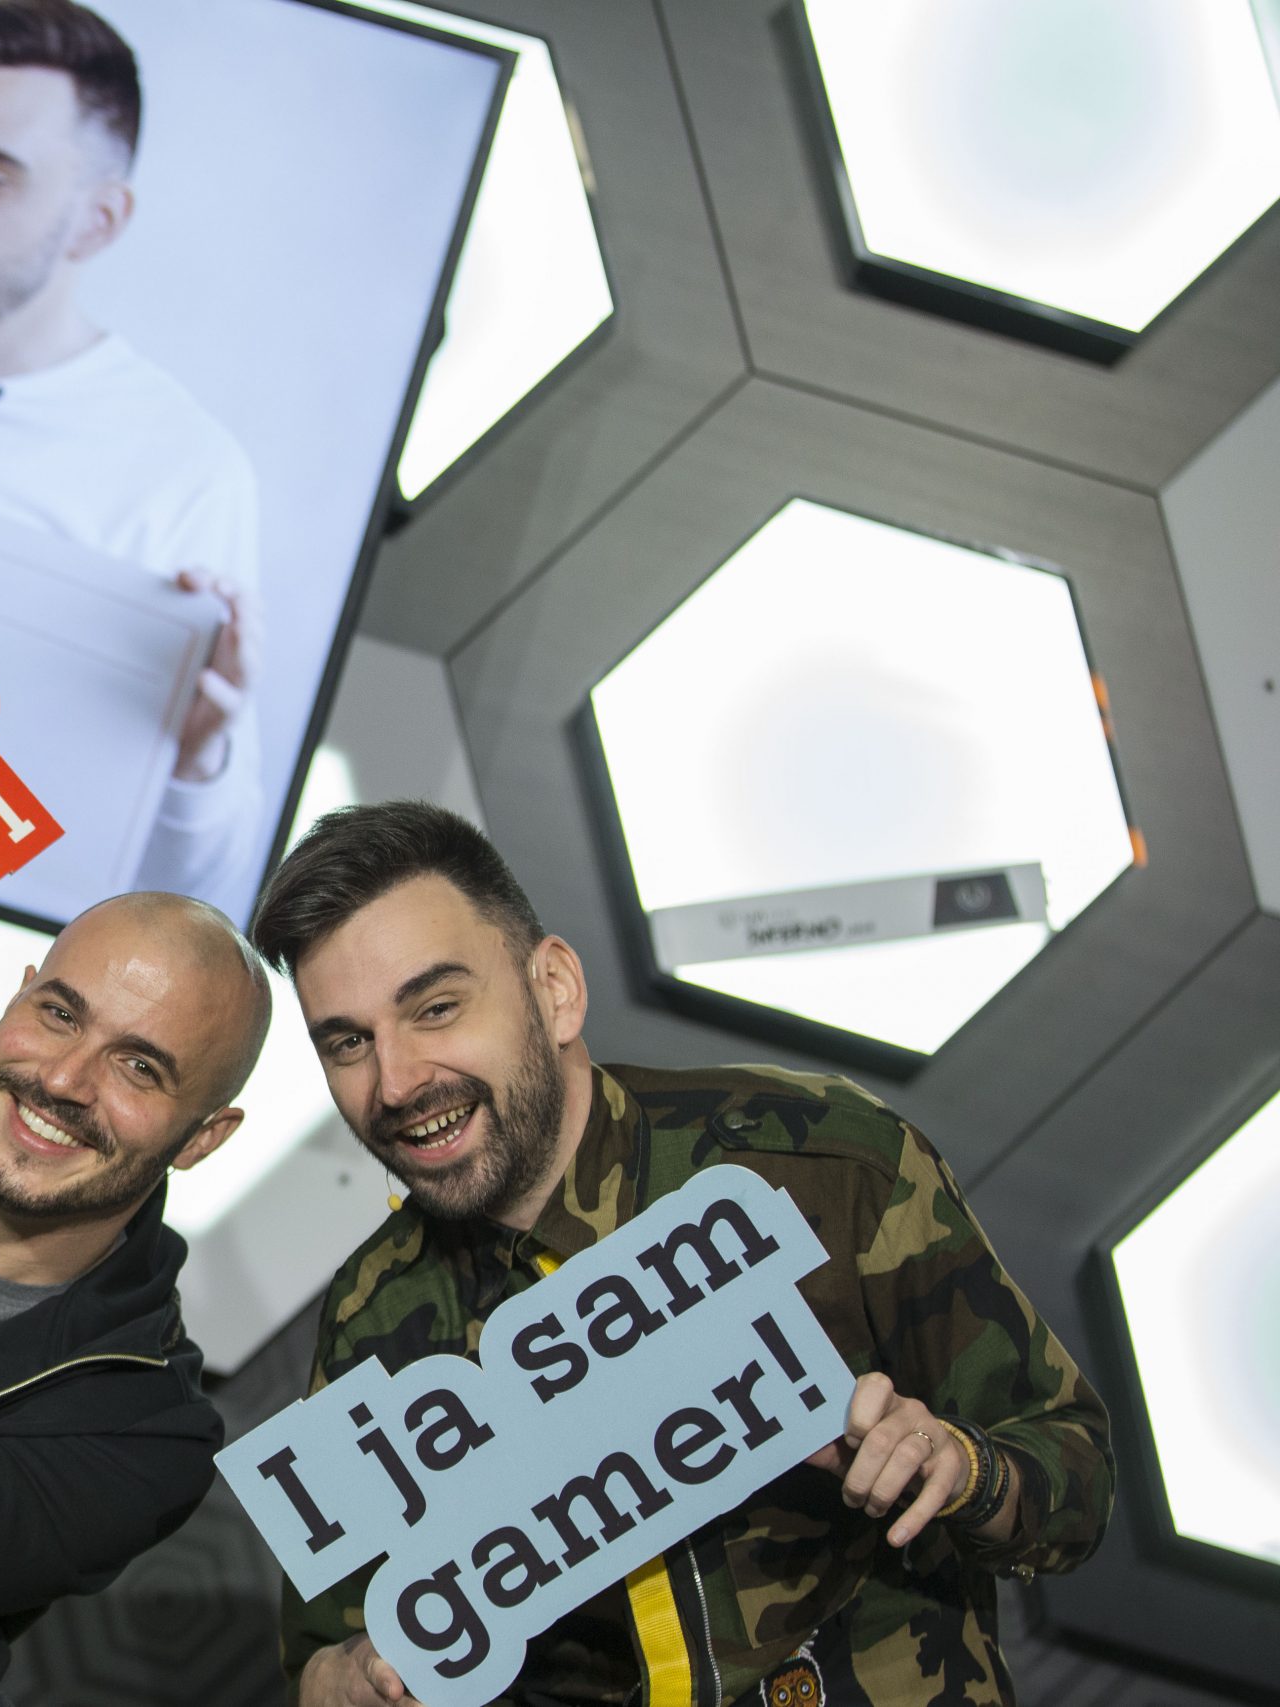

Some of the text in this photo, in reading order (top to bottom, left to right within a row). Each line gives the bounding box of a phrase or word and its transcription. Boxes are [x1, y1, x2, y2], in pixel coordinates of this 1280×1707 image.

[257, 1197, 780, 1555] I ja sam
[395, 1311, 827, 1679] gamer!
